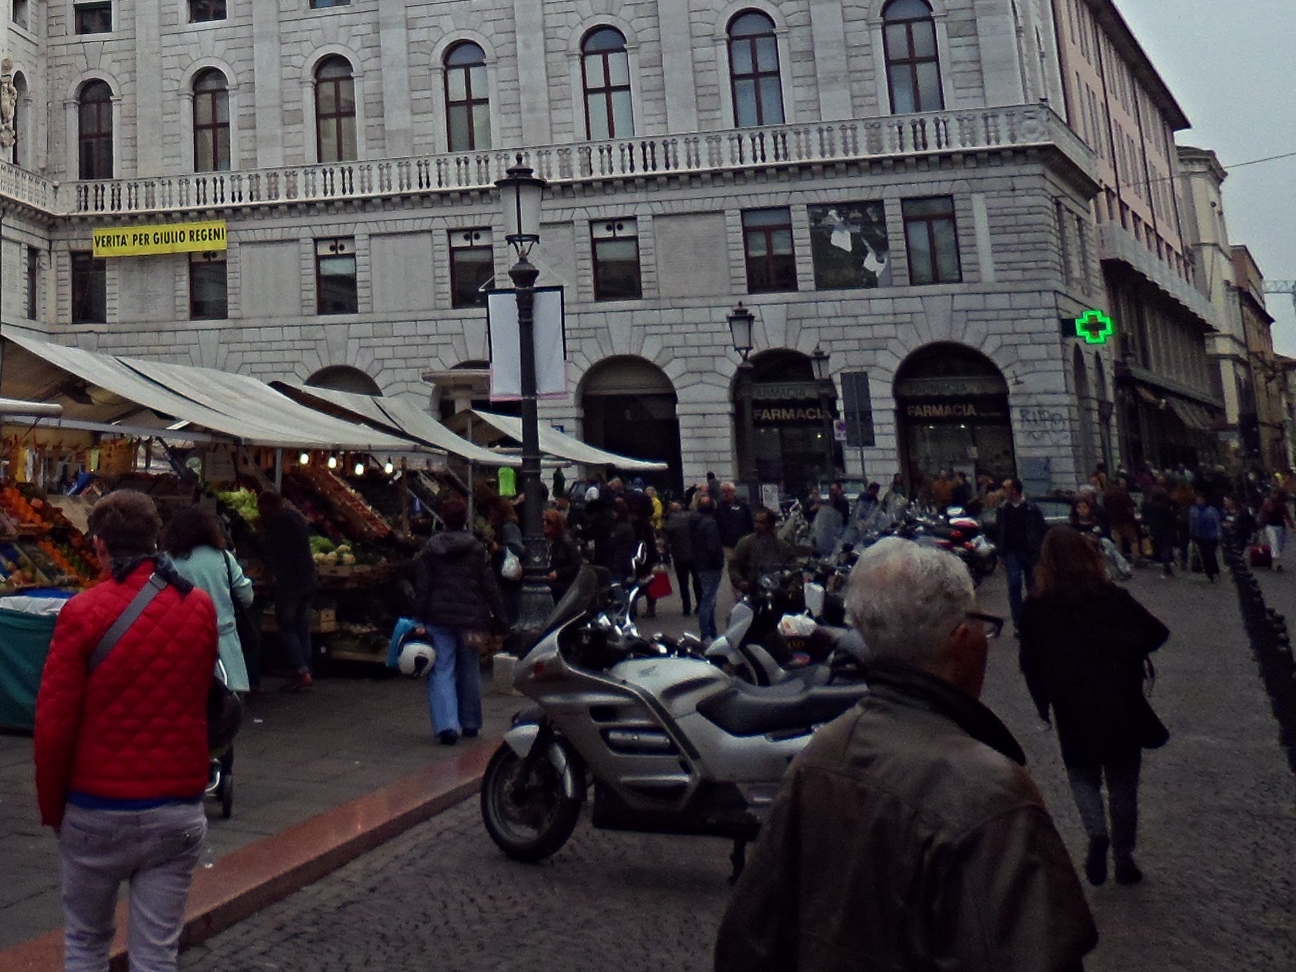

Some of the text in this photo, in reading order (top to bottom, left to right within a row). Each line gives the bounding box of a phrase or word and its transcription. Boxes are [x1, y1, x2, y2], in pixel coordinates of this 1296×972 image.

[132, 233, 150, 246] PER
[153, 230, 186, 245] GIULIO
[189, 227, 225, 242] REGENI
[753, 408, 833, 421] FARMACIA
[907, 403, 978, 417] FARMACIA
